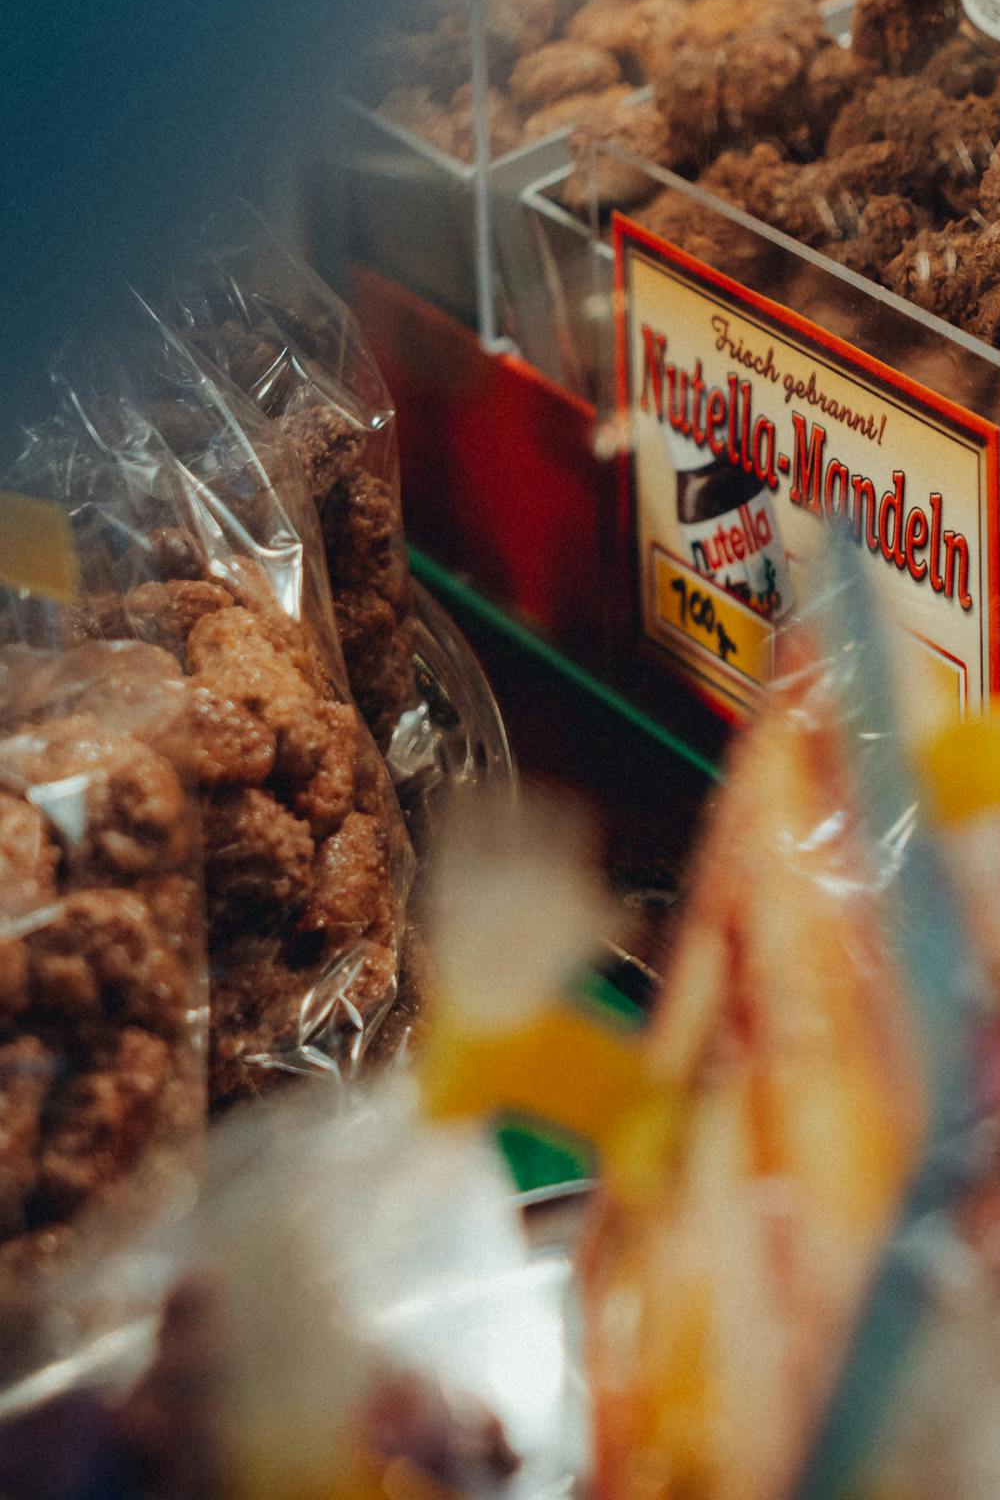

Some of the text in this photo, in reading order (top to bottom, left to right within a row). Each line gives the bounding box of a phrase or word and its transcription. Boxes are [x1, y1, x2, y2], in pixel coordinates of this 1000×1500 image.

[710, 313, 887, 447] Frisch gebrannt!
[639, 322, 973, 612] Nutella-Mandeln
[691, 503, 773, 574] nutella
